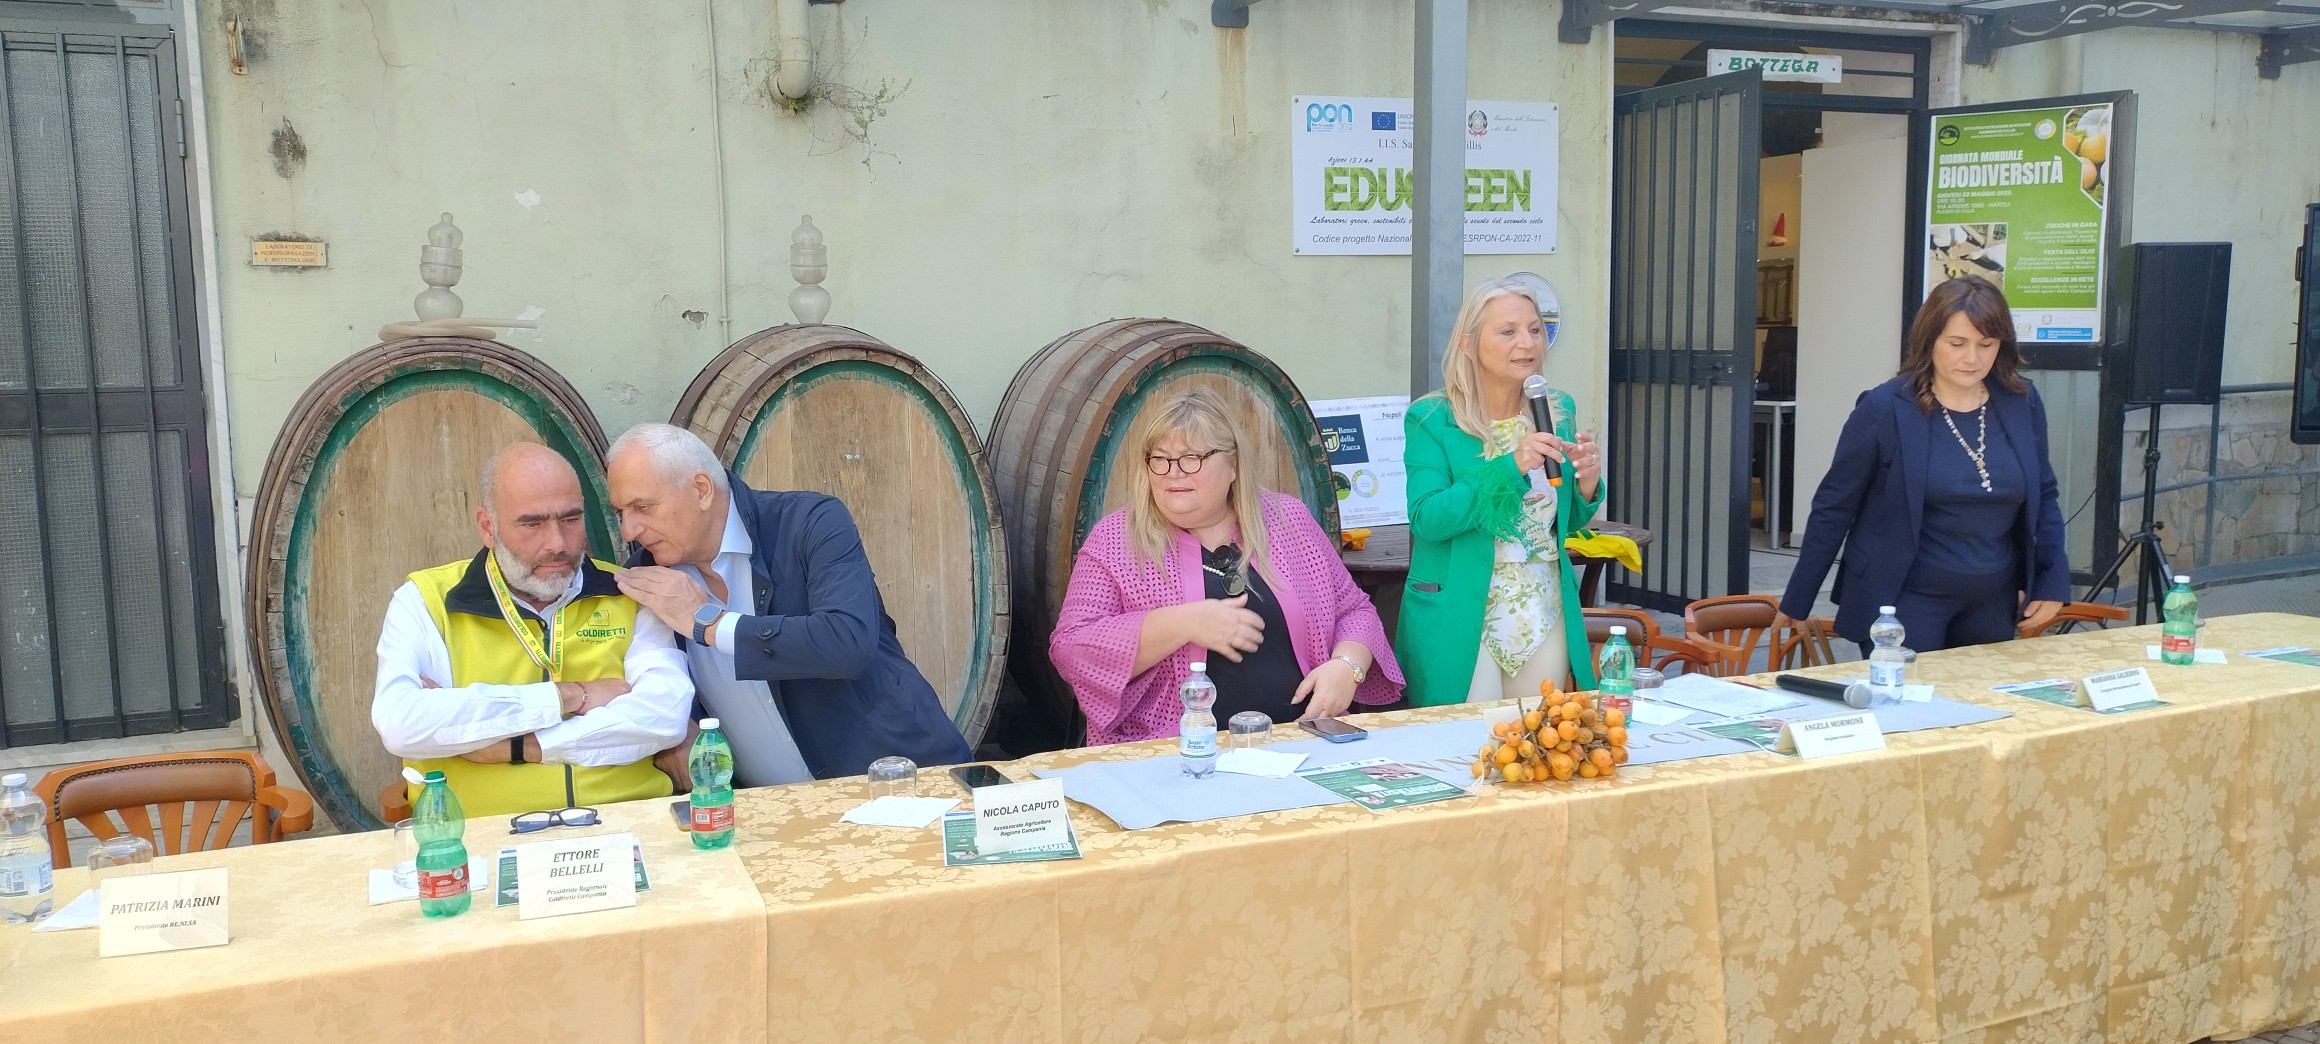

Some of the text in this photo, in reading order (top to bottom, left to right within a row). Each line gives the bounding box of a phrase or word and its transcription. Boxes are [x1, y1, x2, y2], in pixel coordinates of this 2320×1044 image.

[1728, 57, 1819, 73] BOTTEGA
[1379, 139, 1399, 149] I.I.S.
[1466, 140, 1481, 150] illis
[1940, 150, 2023, 164] GIORNATA MONDIALE
[1938, 155, 2063, 188] BIODIVERSITÀ
[1310, 216, 1347, 224] Laboratori
[1373, 216, 1406, 224] sostenibili
[1312, 234, 1542, 245] Codice progetto Nazional ESRPON-CA-2022-11
[576, 627, 626, 637] COLDIRETTI
[1804, 717, 1864, 731] ANGELA MORMONE
[983, 800, 1059, 817] NICOLA CAPUTO
[993, 819, 1052, 831] Assessorato Agricoltura
[1022, 826, 1046, 834] Campania
[553, 848, 600, 863] ETTORE
[549, 863, 604, 878] BELLELLI
[547, 884, 608, 895] Presidente Regionale
[577, 891, 607, 900] Campania
[111, 895, 221, 915] PATRIZIA MARINI
[134, 922, 168, 931] Presidente
